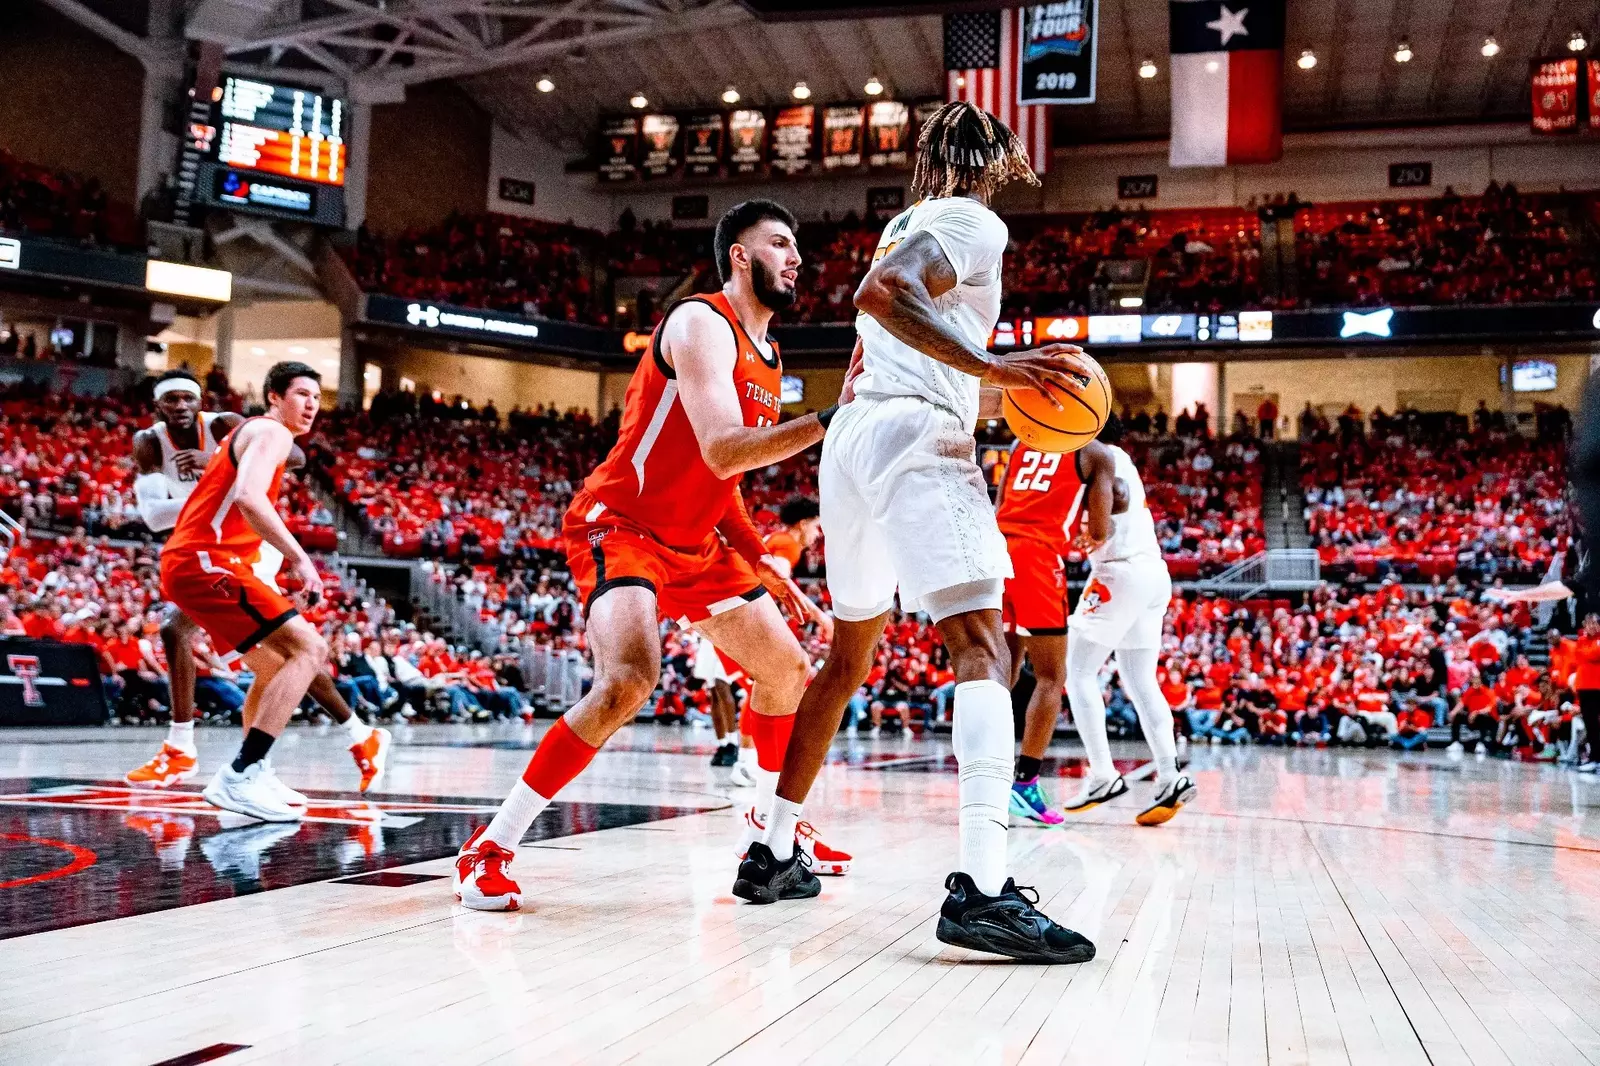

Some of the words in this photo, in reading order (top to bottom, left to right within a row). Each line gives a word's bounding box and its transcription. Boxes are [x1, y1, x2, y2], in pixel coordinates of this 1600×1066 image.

[1036, 72, 1077, 91] 2019
[745, 381, 773, 408] TEXAS
[1012, 450, 1063, 492] 22
